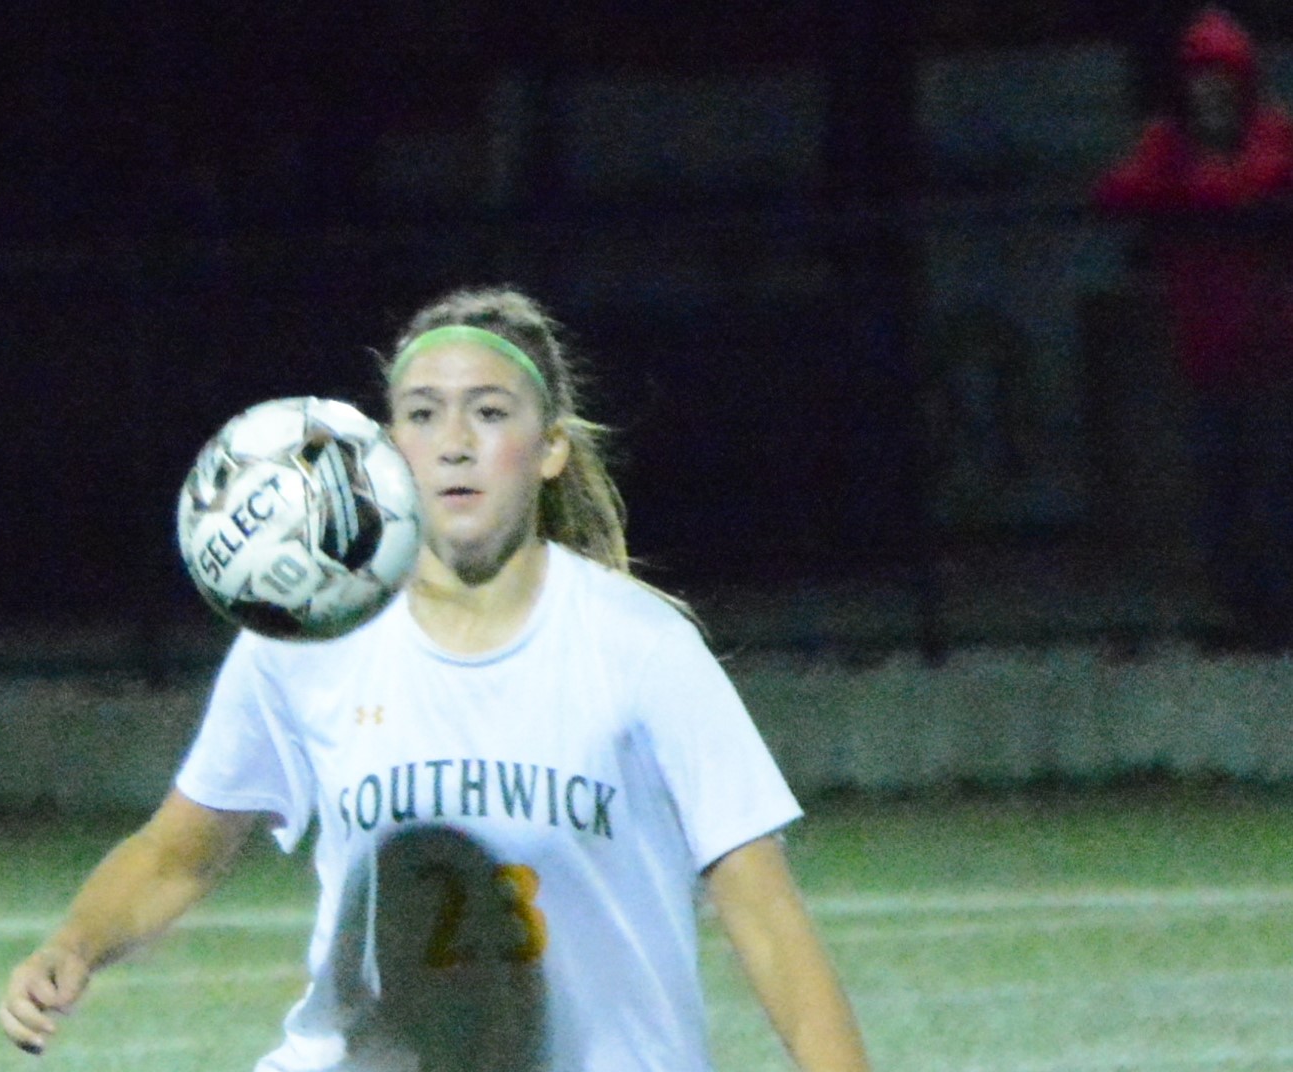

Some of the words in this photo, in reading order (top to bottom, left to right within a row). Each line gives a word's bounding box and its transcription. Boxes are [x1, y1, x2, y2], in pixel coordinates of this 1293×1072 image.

[198, 473, 291, 584] SELECT
[259, 555, 307, 594] 10
[339, 758, 617, 841] SOUTHWICK
[419, 863, 548, 968] 23
